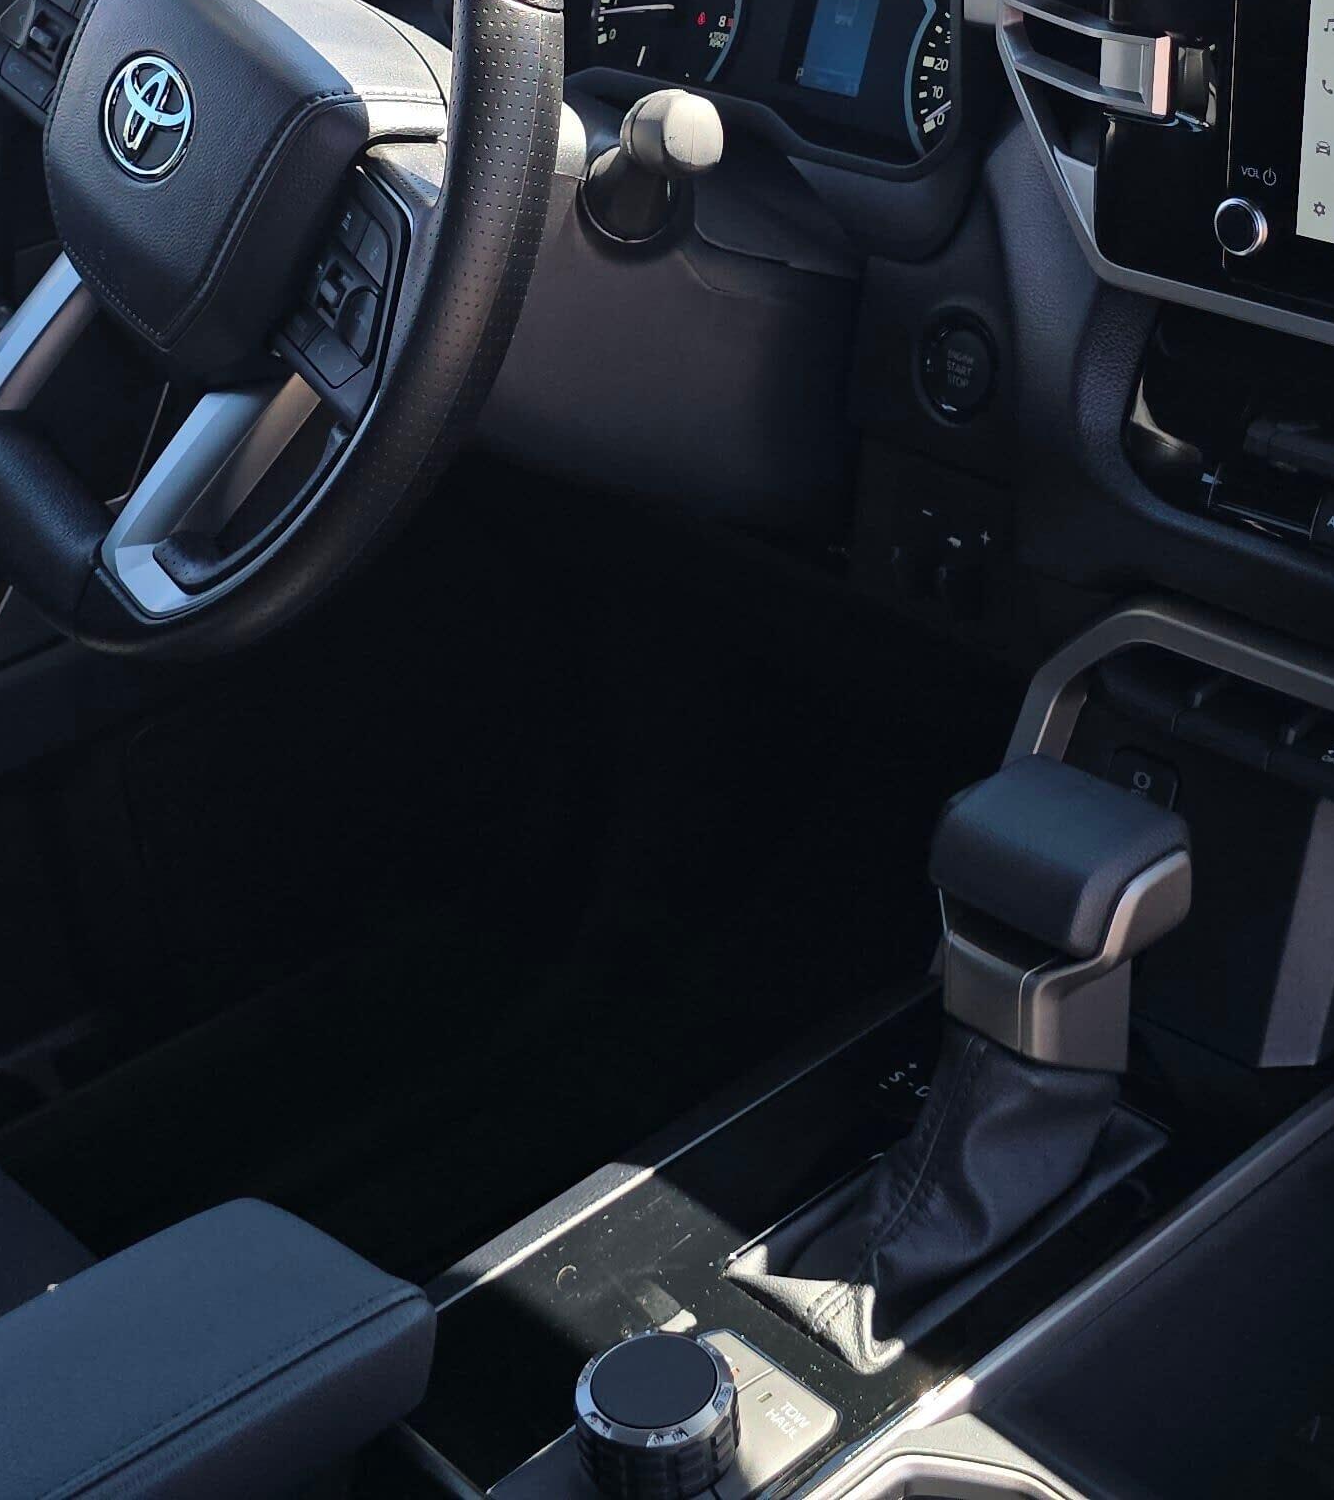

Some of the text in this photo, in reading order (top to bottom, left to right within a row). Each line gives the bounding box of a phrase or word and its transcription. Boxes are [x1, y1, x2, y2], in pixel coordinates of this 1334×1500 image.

[718, 15, 727, 27] 8
[608, 28, 616, 40] 0
[933, 58, 949, 72] 20
[931, 85, 944, 100] 10
[1241, 165, 1260, 179] VOL
[780, 1401, 811, 1429] TOW
